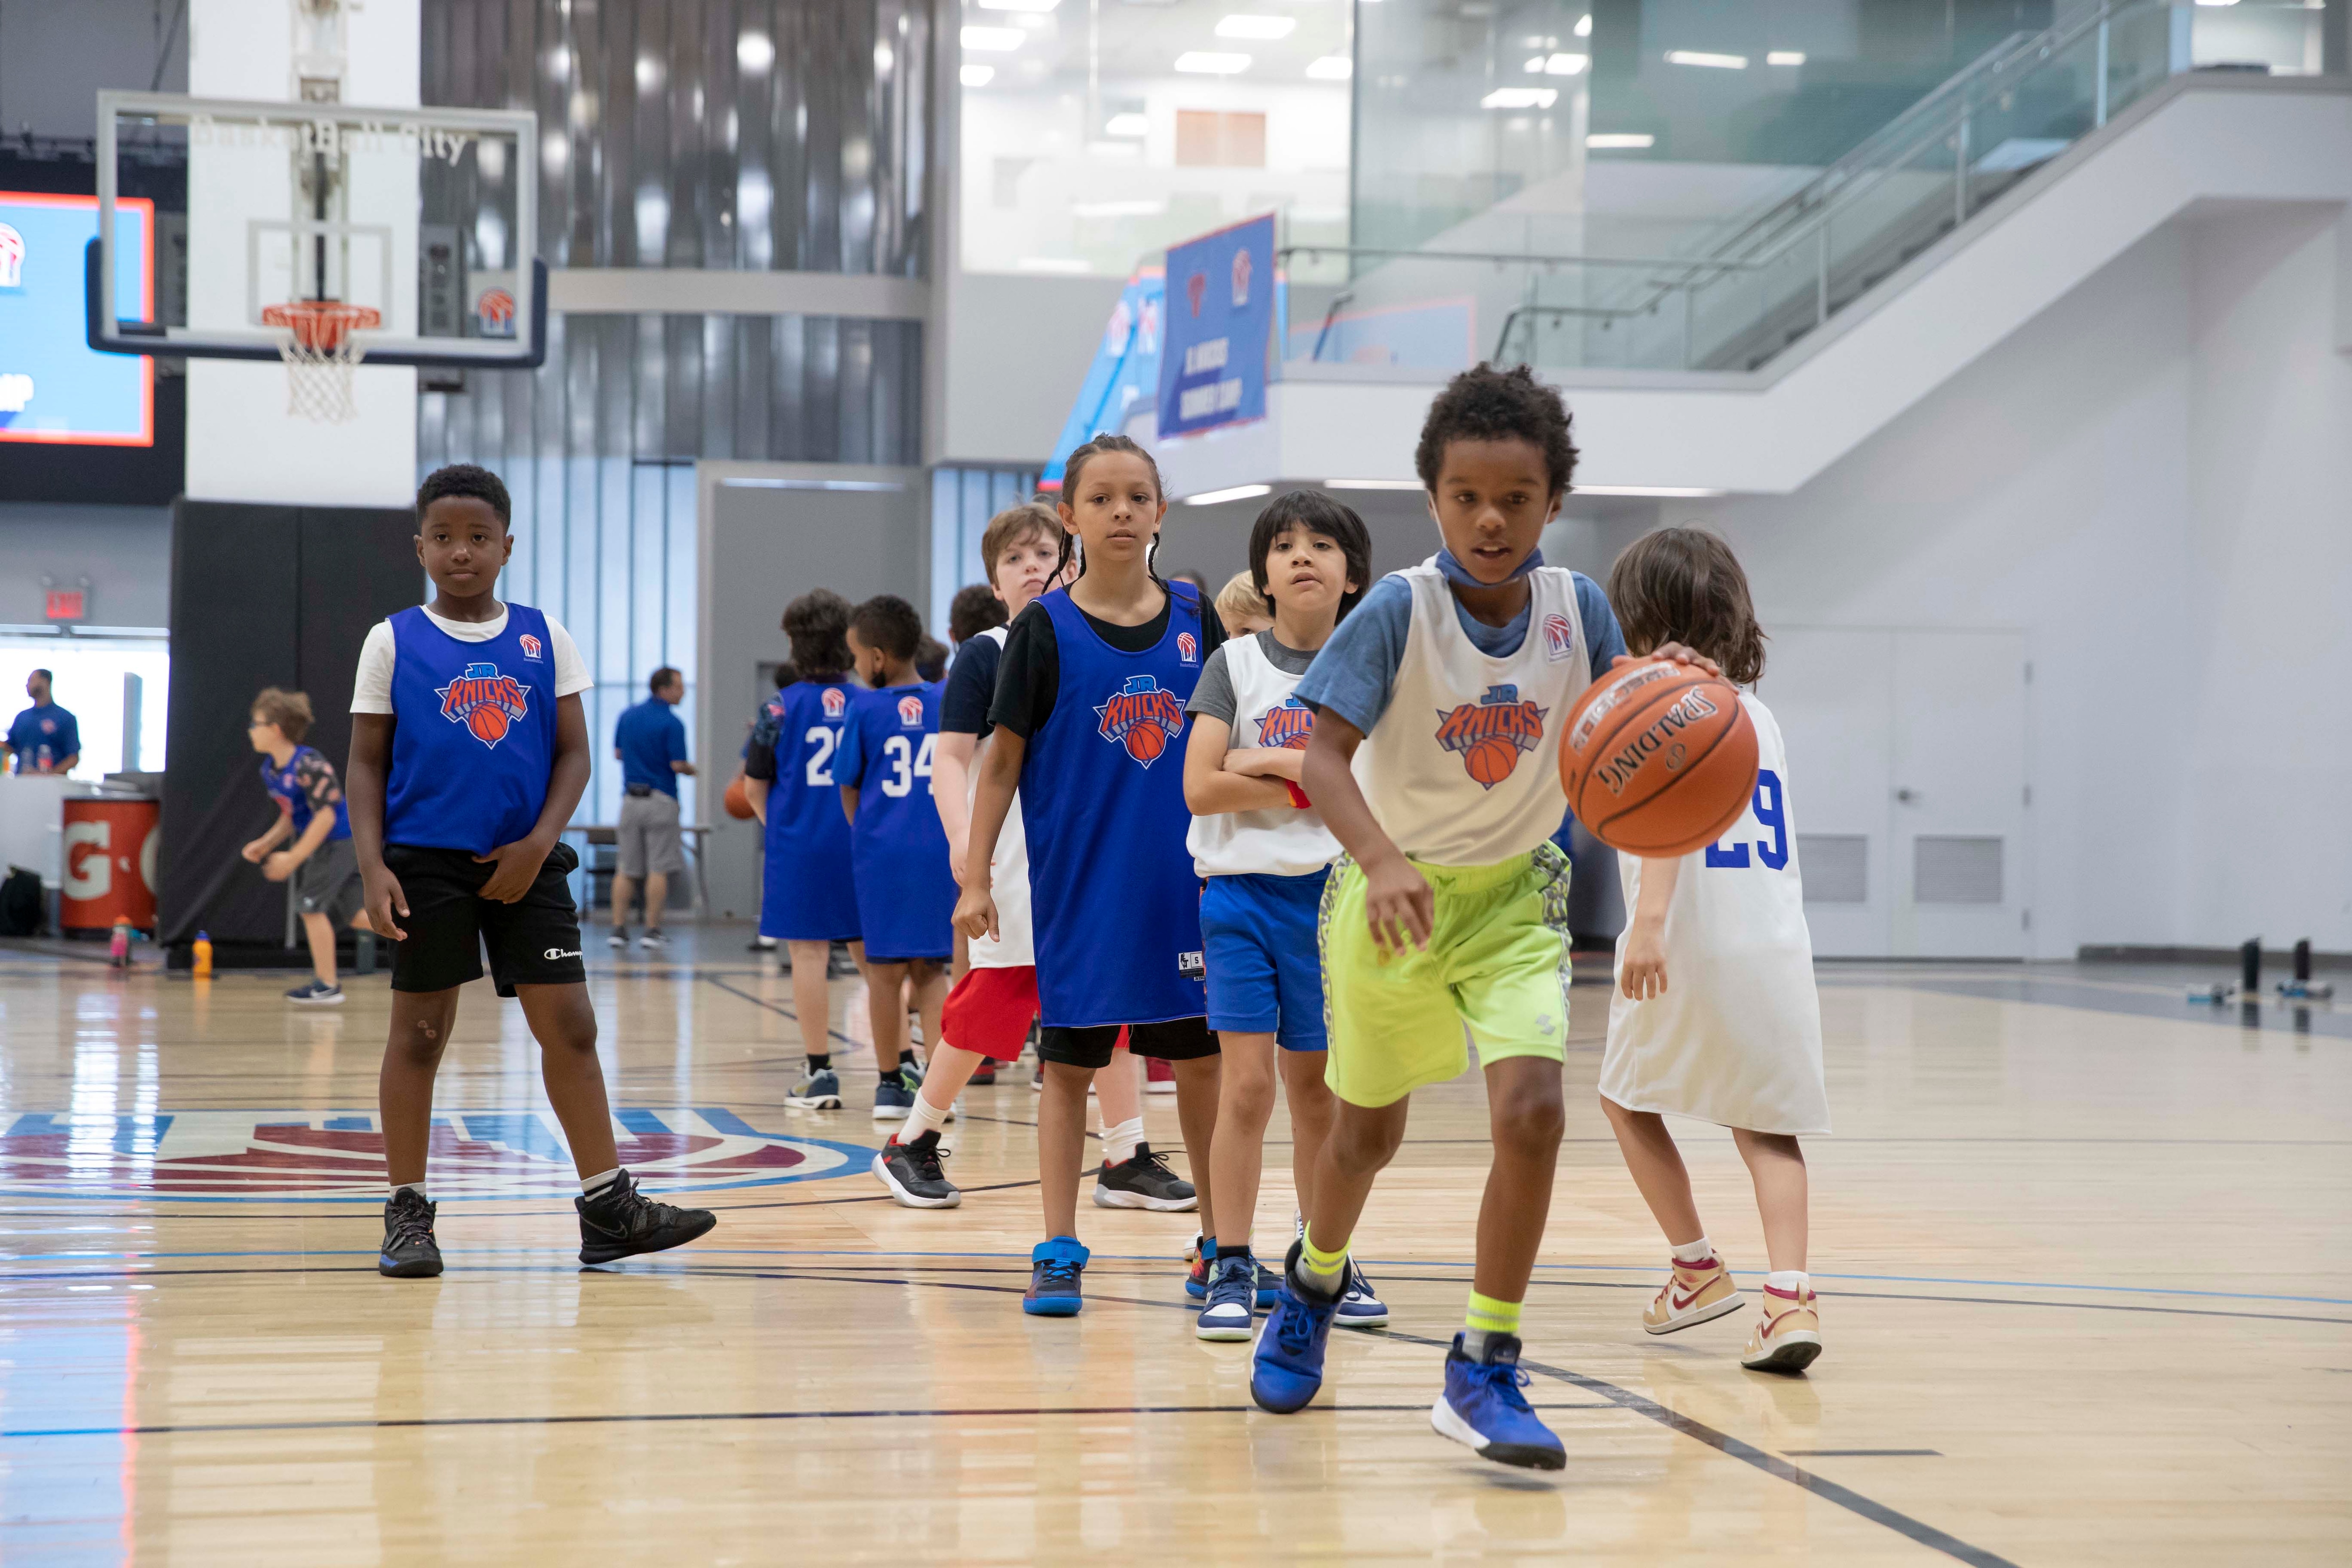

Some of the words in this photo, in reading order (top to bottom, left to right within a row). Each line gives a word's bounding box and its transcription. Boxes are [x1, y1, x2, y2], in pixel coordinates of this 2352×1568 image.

[467, 664, 496, 678] JR
[1125, 677, 1156, 692] JR
[443, 677, 525, 713] KNICKS
[1101, 689, 1184, 732] KNICKS
[1286, 692, 1307, 708] J
[1480, 684, 1519, 705] JR
[1258, 707, 1316, 744] KNIC
[1435, 701, 1544, 739] KNICKS
[805, 726, 845, 787] 2
[1597, 685, 1719, 796] SPALDING
[882, 733, 938, 797] 34
[544, 948, 583, 960] Champ
